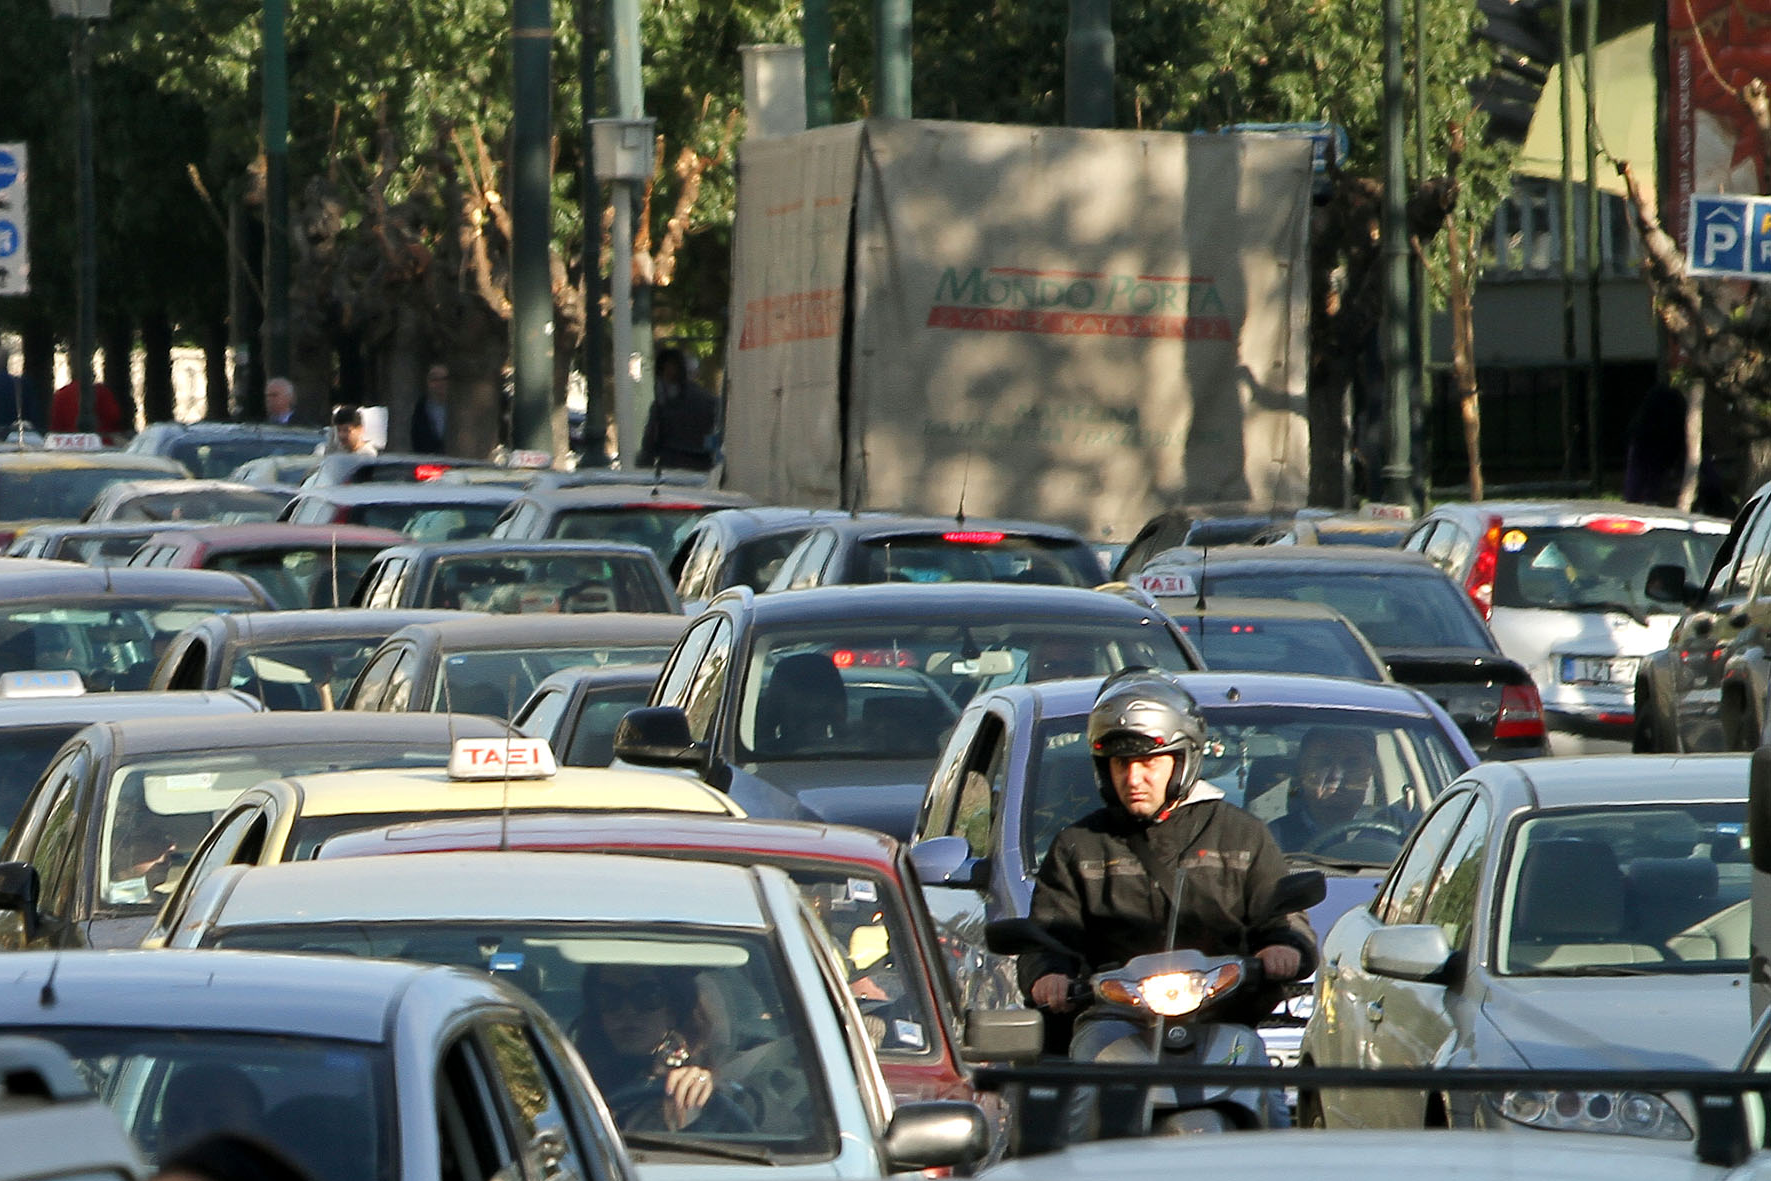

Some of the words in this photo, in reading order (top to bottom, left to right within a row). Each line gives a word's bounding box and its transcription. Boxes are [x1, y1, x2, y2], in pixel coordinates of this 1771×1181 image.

[1704, 224, 1738, 265] P
[934, 267, 1097, 309] MONDO
[1102, 273, 1226, 314] PORTA
[1139, 576, 1184, 592] ΤΑΞΙ
[461, 748, 539, 765] ΤΑΞΙ
